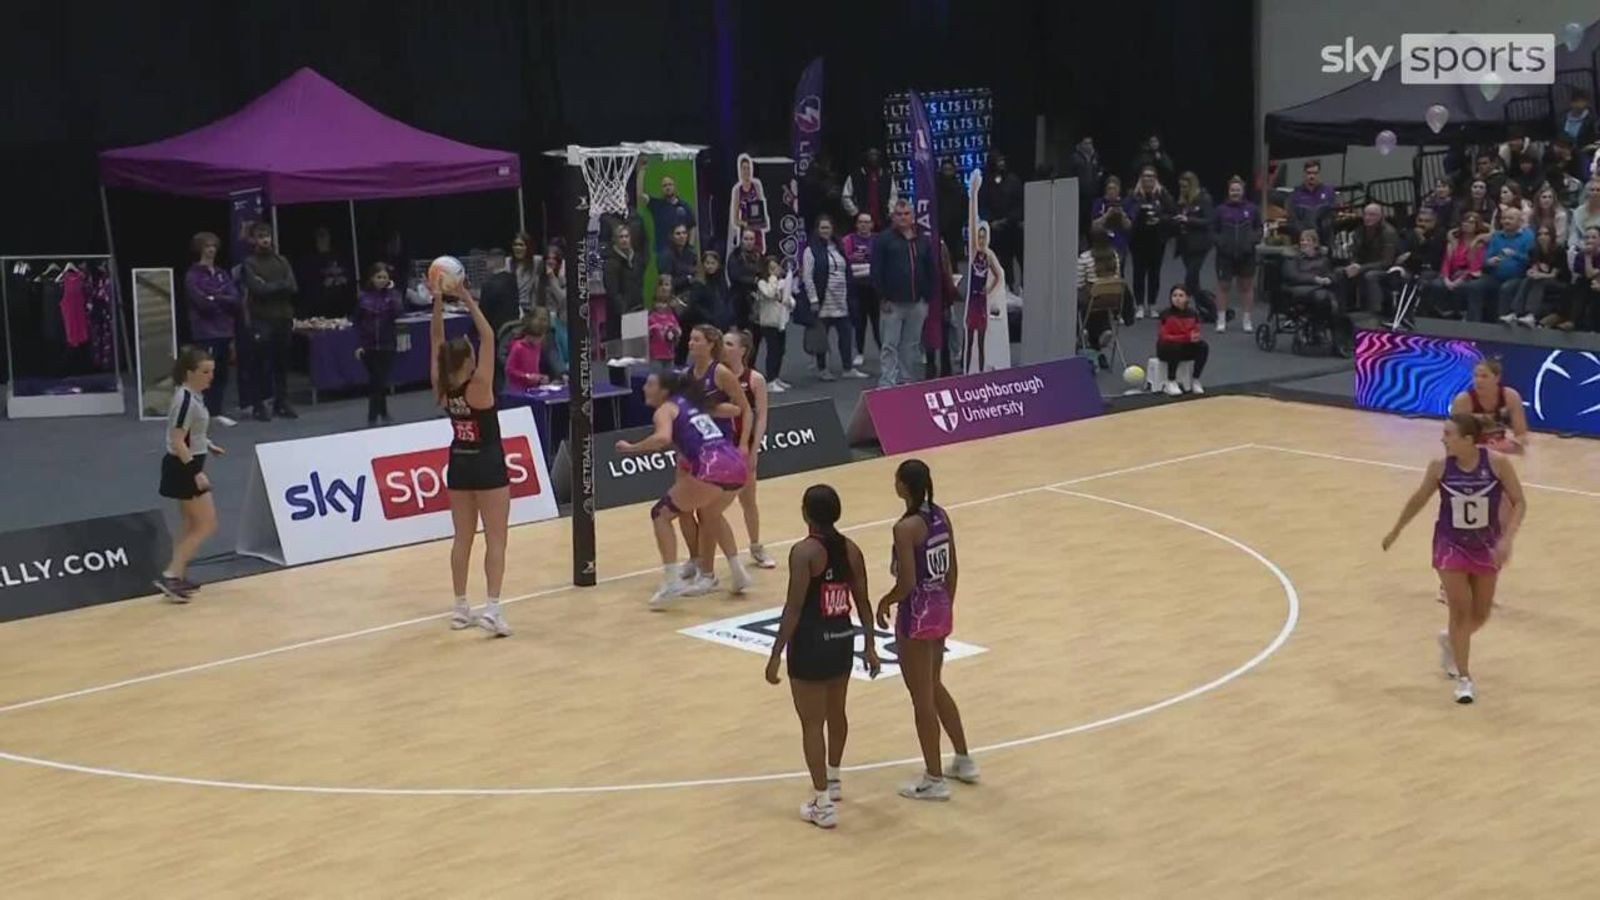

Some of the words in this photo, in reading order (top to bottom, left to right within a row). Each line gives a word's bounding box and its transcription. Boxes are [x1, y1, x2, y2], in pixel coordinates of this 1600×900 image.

[940, 101, 961, 113] LTS
[964, 99, 985, 112] LTS
[953, 117, 973, 130] LTS
[941, 137, 961, 149] LTS
[964, 135, 984, 147] LTS
[953, 153, 973, 166] LTS
[577, 237, 589, 299] NETBALL
[580, 336, 590, 397] NETBALL
[955, 375, 1044, 403] Loughborough
[962, 400, 1025, 422] University
[582, 434, 592, 494] NETBALL
[285, 471, 366, 522] sky
[386, 453, 529, 509] sps
[1463, 500, 1478, 525] C
